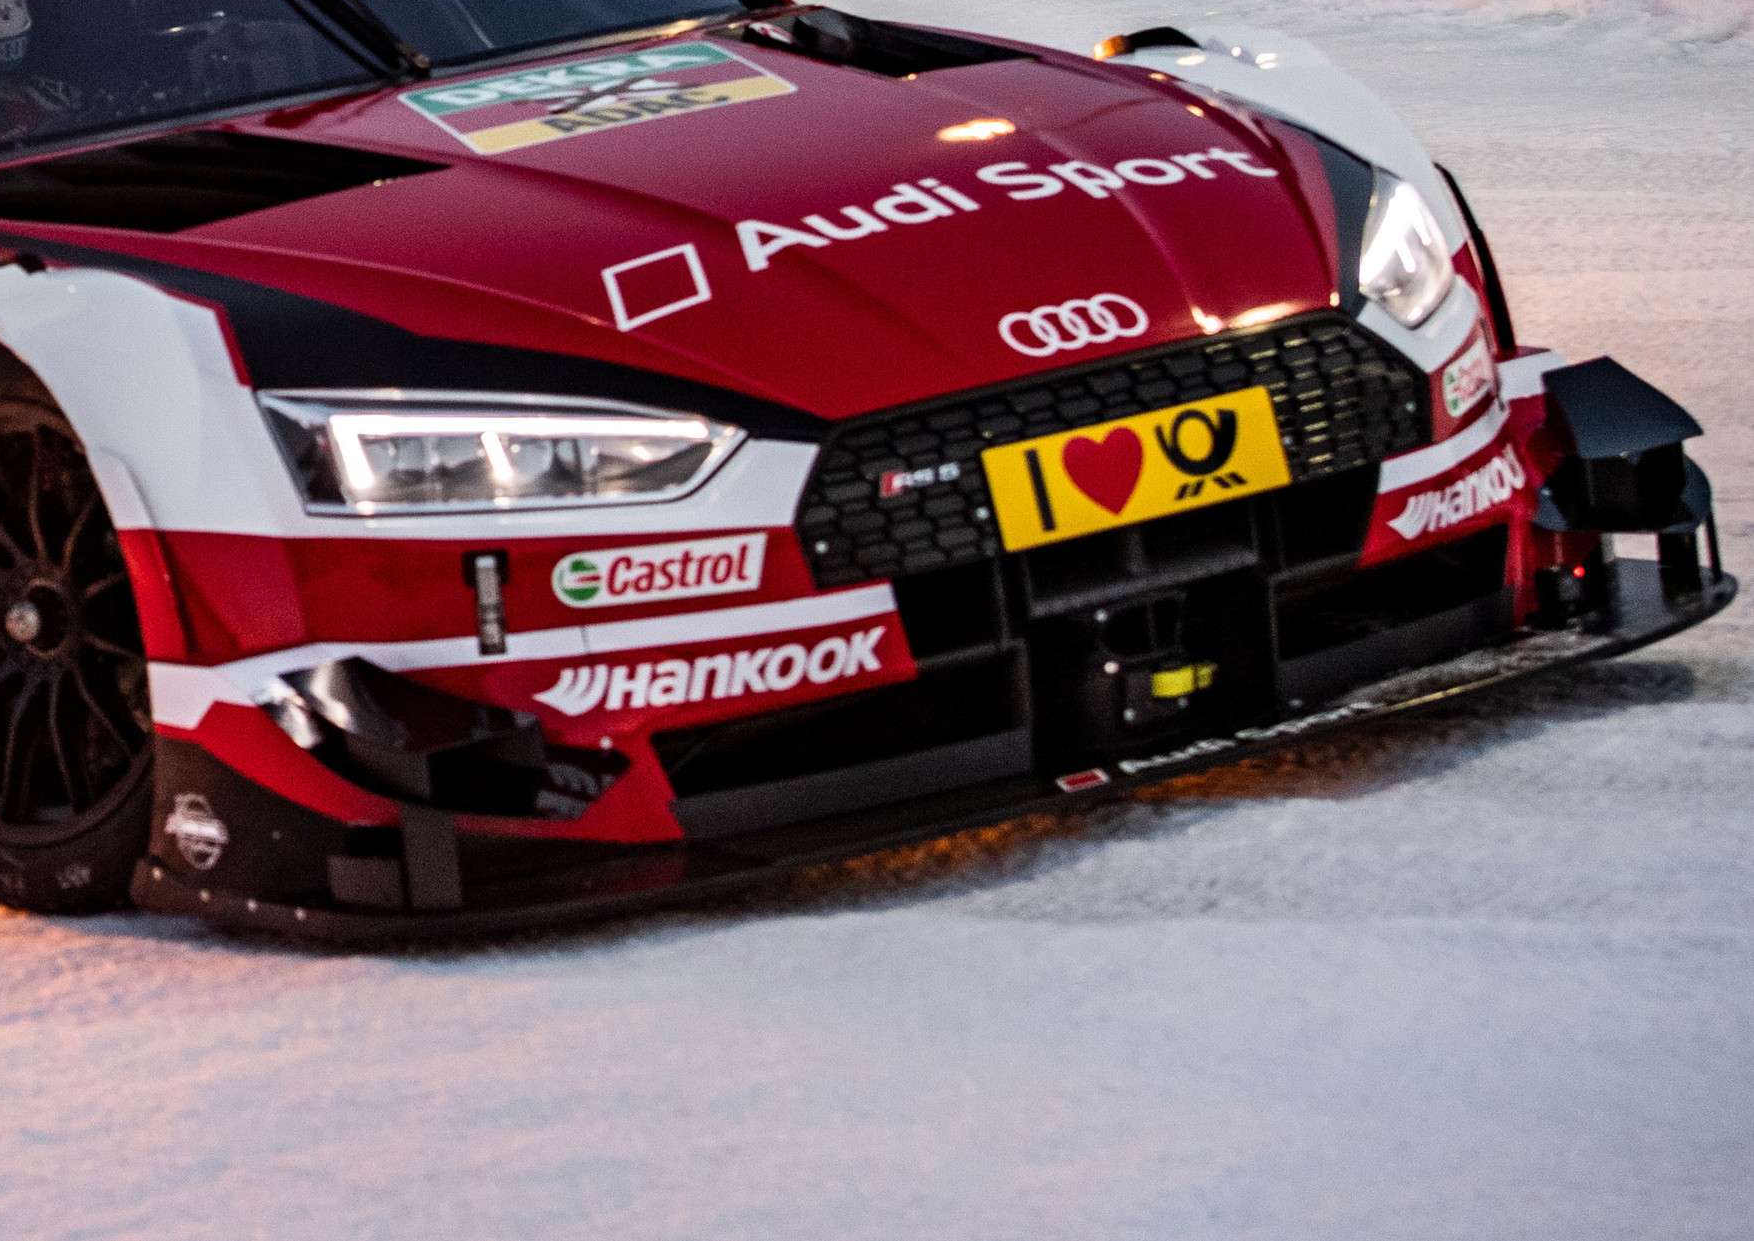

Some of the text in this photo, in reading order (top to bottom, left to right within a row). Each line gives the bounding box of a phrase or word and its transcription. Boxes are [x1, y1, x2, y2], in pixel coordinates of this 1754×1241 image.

[424, 54, 710, 106] DEKRA
[736, 146, 1279, 274] Audi Sport
[607, 543, 749, 597] Castrol
